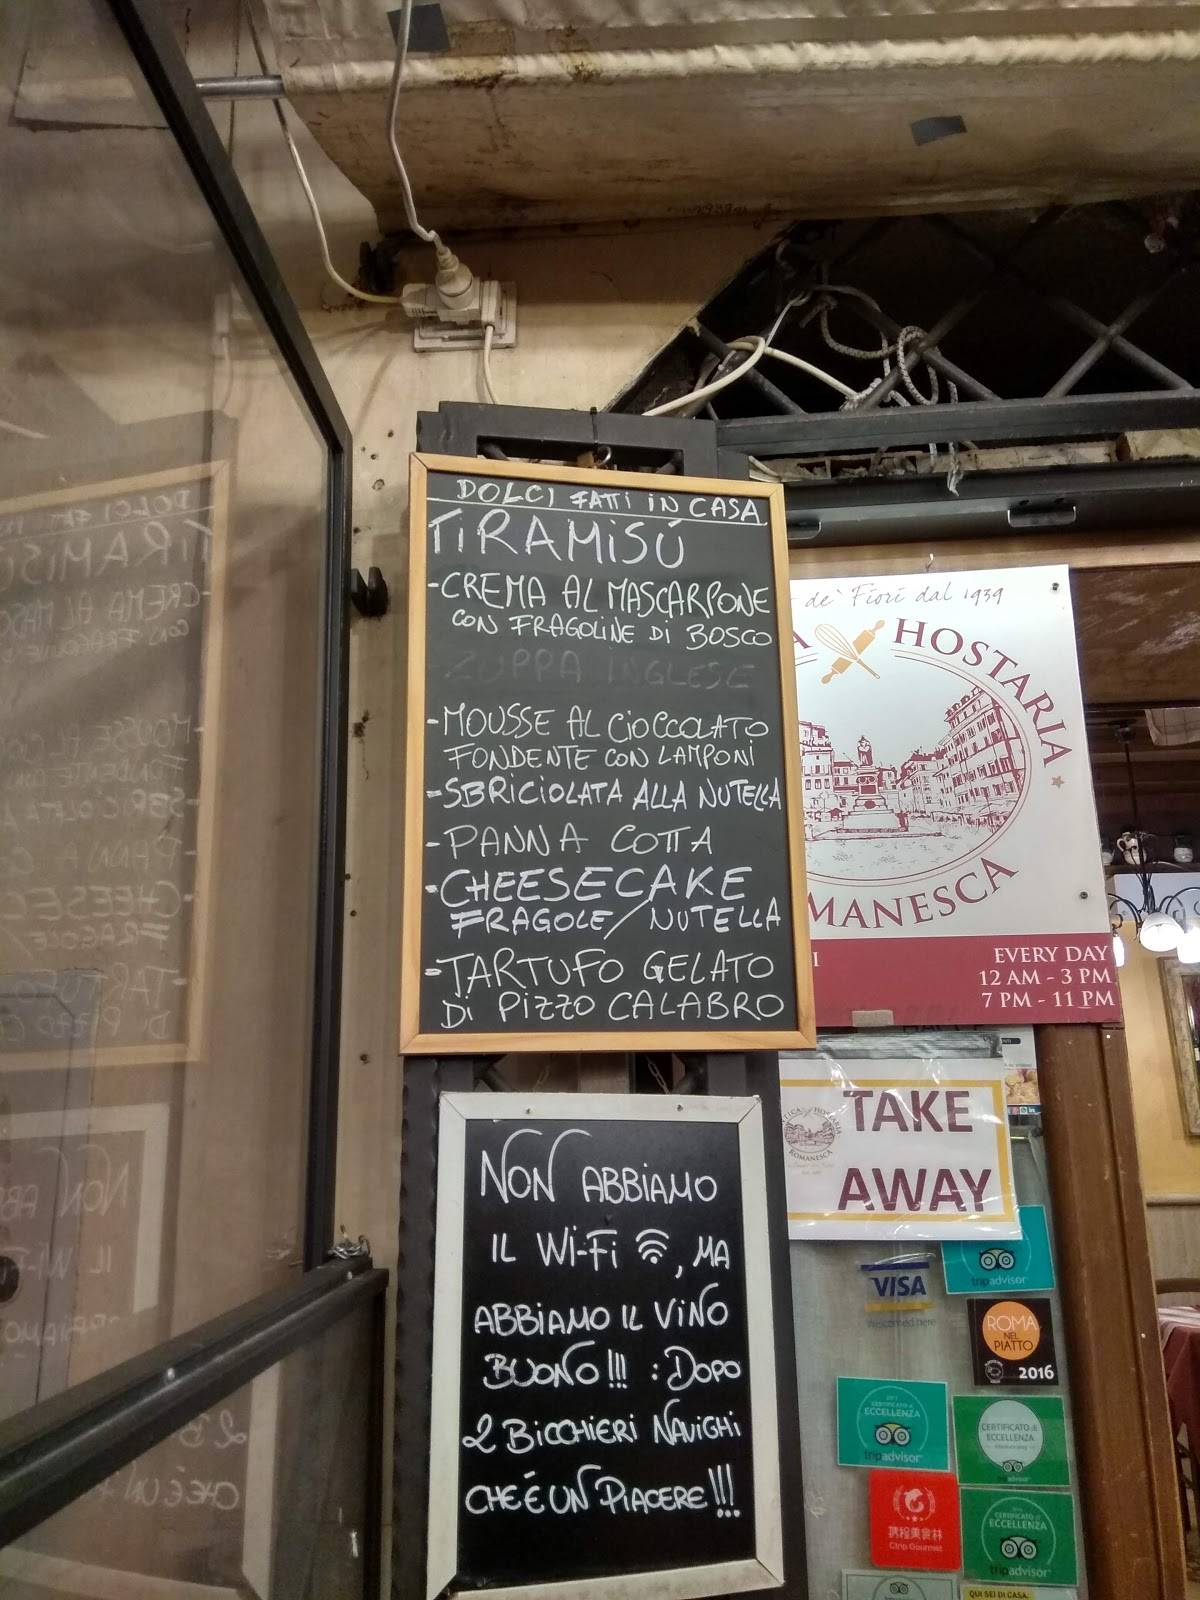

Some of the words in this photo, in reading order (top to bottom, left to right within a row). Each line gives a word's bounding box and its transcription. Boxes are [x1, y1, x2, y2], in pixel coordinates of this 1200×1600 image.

[456, 479, 554, 508] DOLCI
[690, 497, 762, 523] CASA
[562, 574, 599, 613] AL
[607, 577, 771, 618] MASCARPONE
[850, 582, 906, 608] Fiori
[915, 581, 953, 603] dal
[964, 587, 1004, 607] 1939
[452, 609, 499, 635] CON
[686, 624, 772, 650] BOSCO
[893, 617, 1073, 768] HOSTARIA
[566, 704, 601, 741] AL
[444, 743, 600, 771] FONDENTE
[604, 747, 649, 769] CON
[632, 778, 688, 812] ALLA
[699, 777, 783, 812] NUTELLA
[610, 824, 713, 856] COTTA
[649, 897, 783, 933] NUTELLA
[643, 950, 774, 984] GELATO
[994, 947, 1058, 964] EVERY
[1065, 945, 1109, 962] DAY
[978, 969, 1001, 986] 12
[1007, 969, 1041, 986] AM
[1060, 968, 1073, 984] 3
[1079, 967, 1113, 984] PM
[608, 990, 784, 1022] CALABRO
[981, 992, 992, 1008] 7
[999, 991, 1032, 1008] PM
[1053, 990, 1073, 1006] 11
[1079, 990, 1115, 1009] PM
[843, 1090, 973, 1133] TAKE
[480, 1128, 591, 1203] NON
[837, 1168, 993, 1212] AWAY
[492, 1233, 517, 1263] IL
[868, 1275, 927, 1297] VISA
[622, 1304, 644, 1332] IL
[986, 1315, 1039, 1331] ROMA
[993, 1339, 1034, 1352] PIATTO
[1003, 1331, 1019, 1341] NEL
[1018, 1364, 1055, 1380] 2016
[864, 1407, 921, 1418] ECCELLENZA
[462, 1413, 497, 1454] 2
[986, 1433, 1034, 1442] ECCELLENZA
[864, 1448, 922, 1463] tripadvisor
[989, 1518, 1048, 1530] ECCELLENZA
[990, 1565, 1051, 1579] tripadvisor
